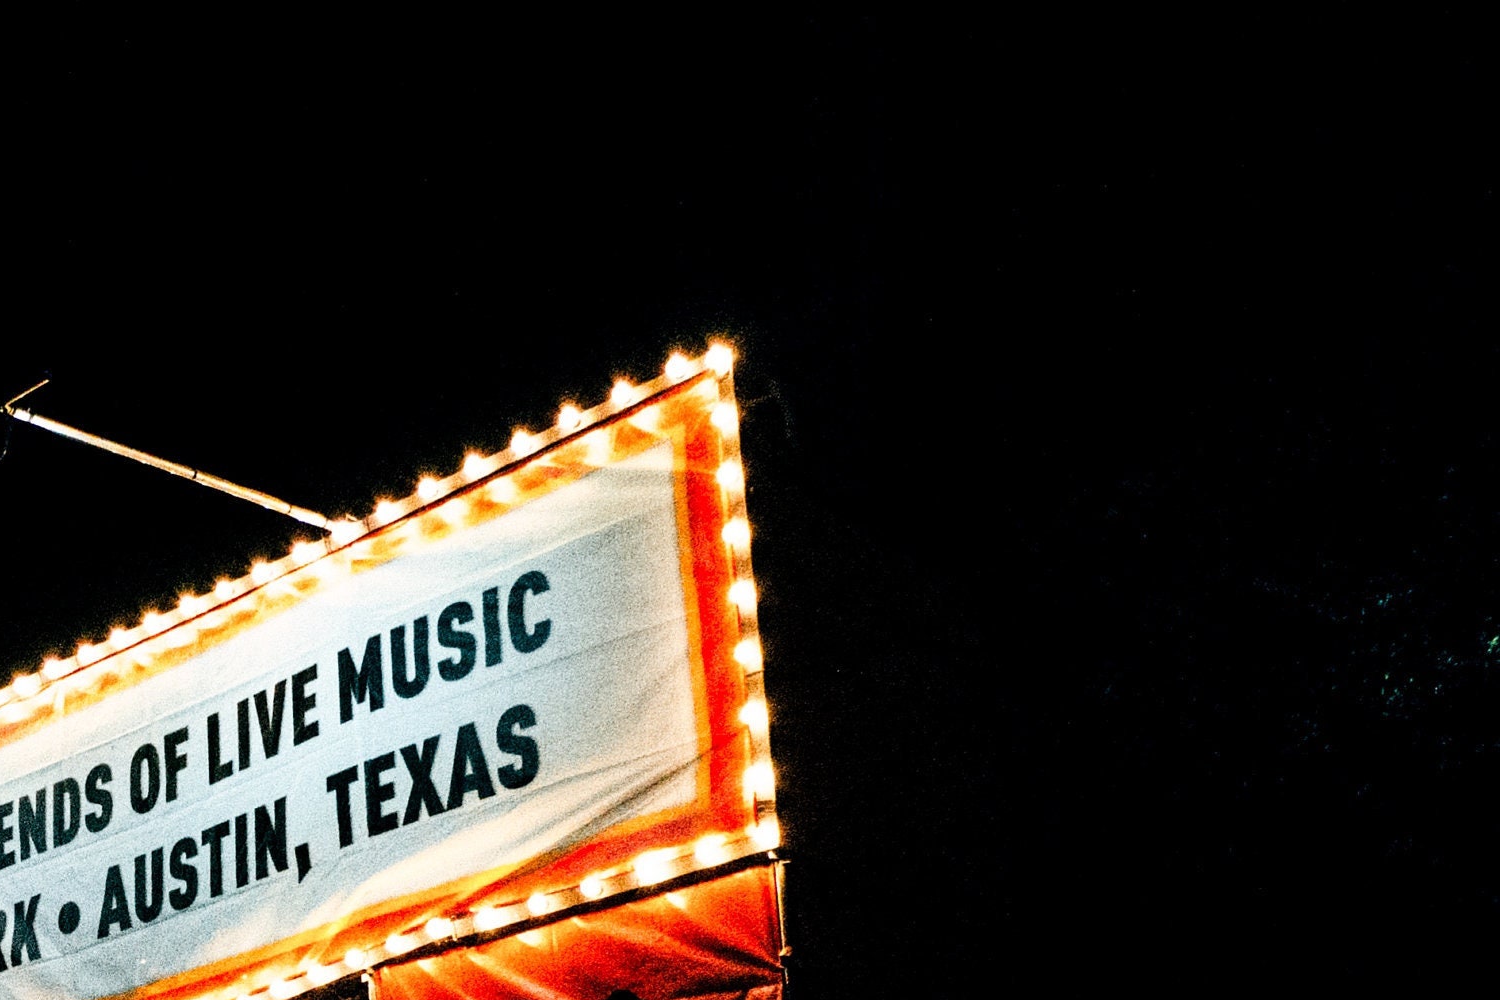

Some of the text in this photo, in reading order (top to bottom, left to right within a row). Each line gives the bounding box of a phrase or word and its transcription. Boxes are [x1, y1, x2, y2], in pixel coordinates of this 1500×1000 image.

[130, 726, 189, 814] OF
[206, 664, 320, 786] LIVE
[338, 570, 552, 724] MUSIC
[96, 797, 312, 941] AUSTIN,
[327, 704, 541, 849] TEXAS
